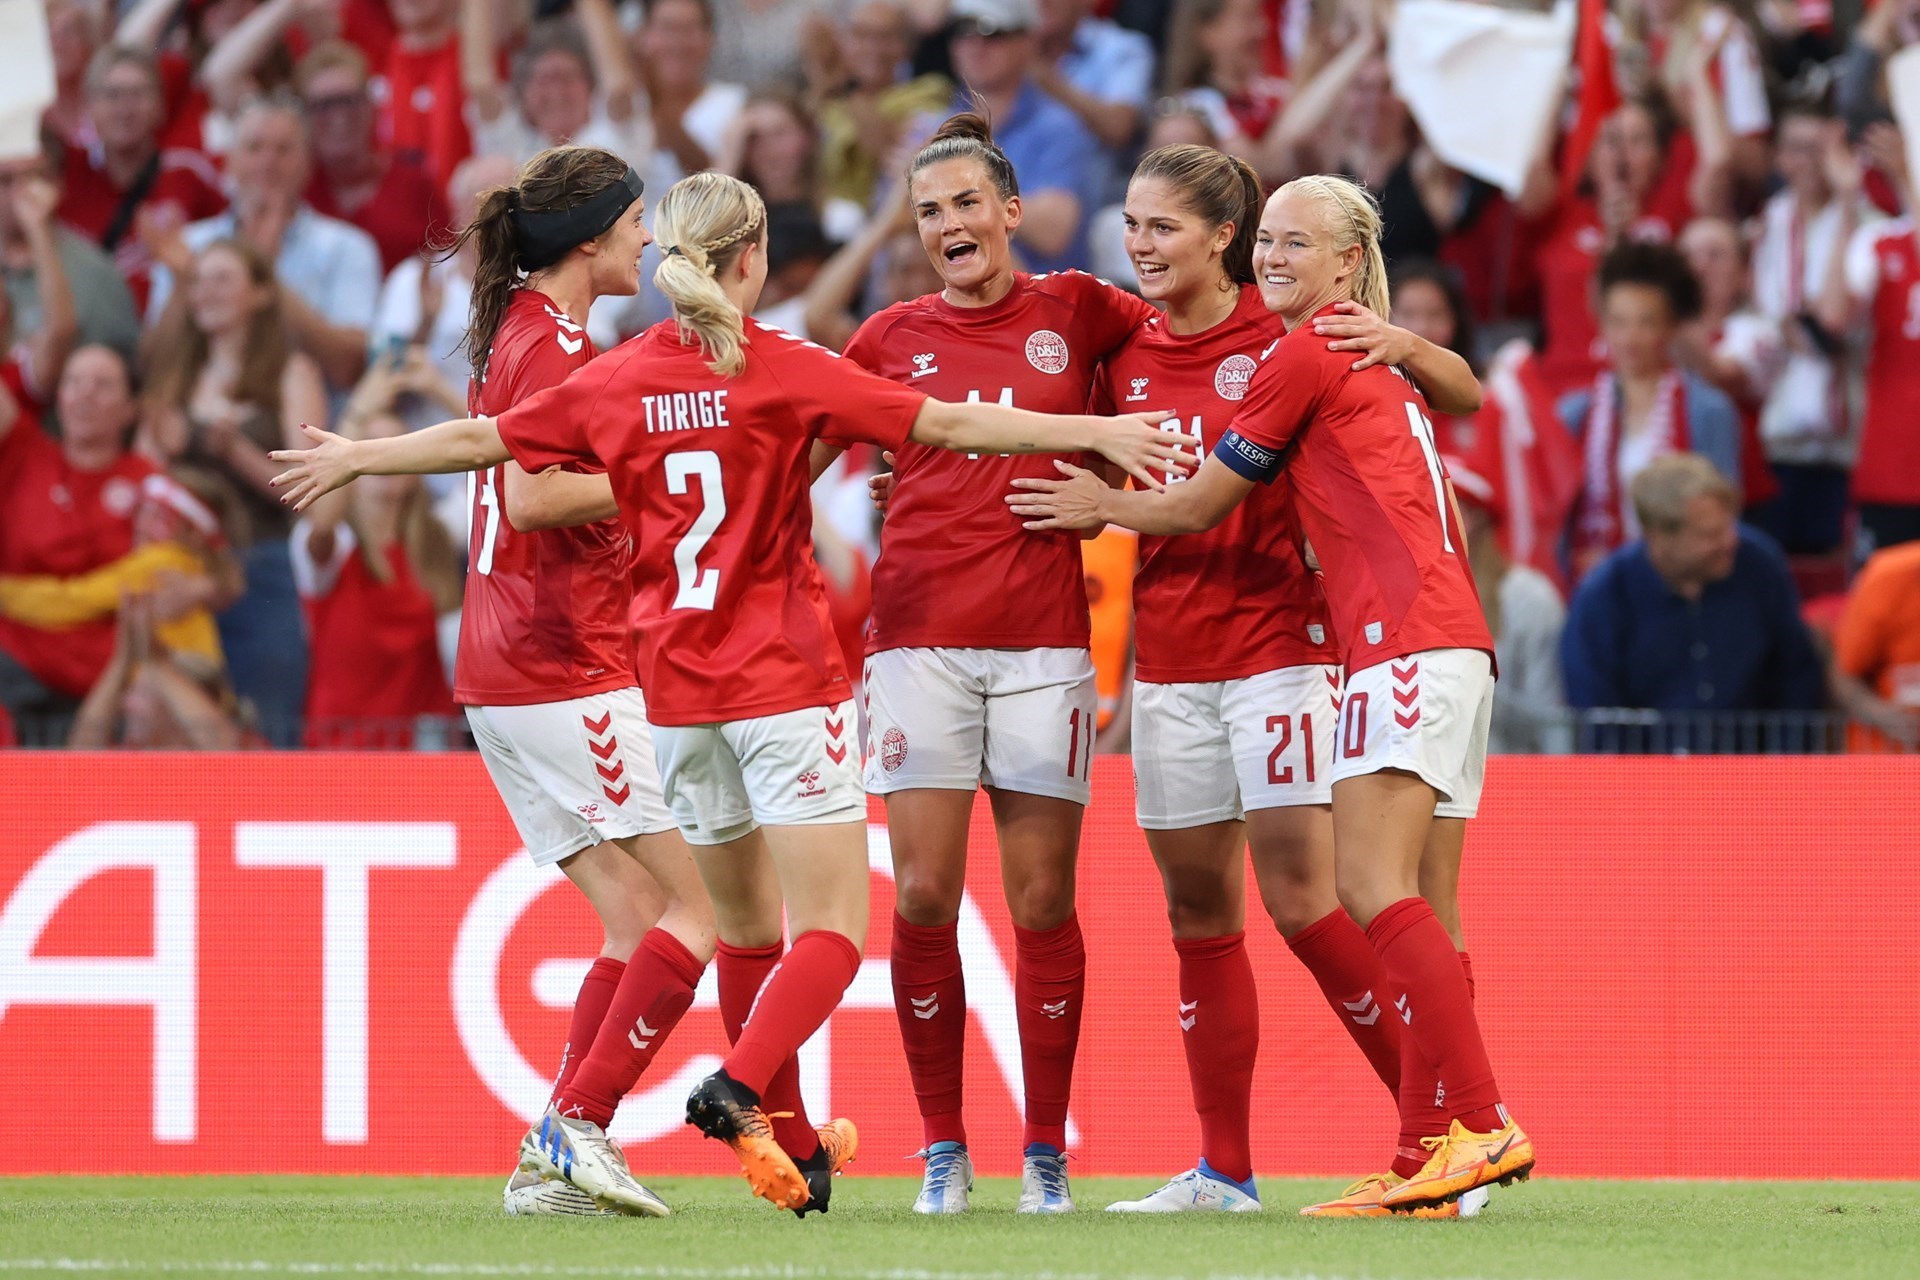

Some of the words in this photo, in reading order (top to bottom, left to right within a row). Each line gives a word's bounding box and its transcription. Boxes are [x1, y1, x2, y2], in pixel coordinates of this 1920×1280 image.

[1035, 344, 1061, 358] DBU
[1224, 370, 1249, 384] DBU
[642, 389, 730, 433] THRIGE
[1404, 401, 1455, 554] 1
[664, 449, 727, 611] 2
[1067, 707, 1091, 782] 11
[1265, 713, 1315, 784] 21
[797, 786, 827, 798] hummel
